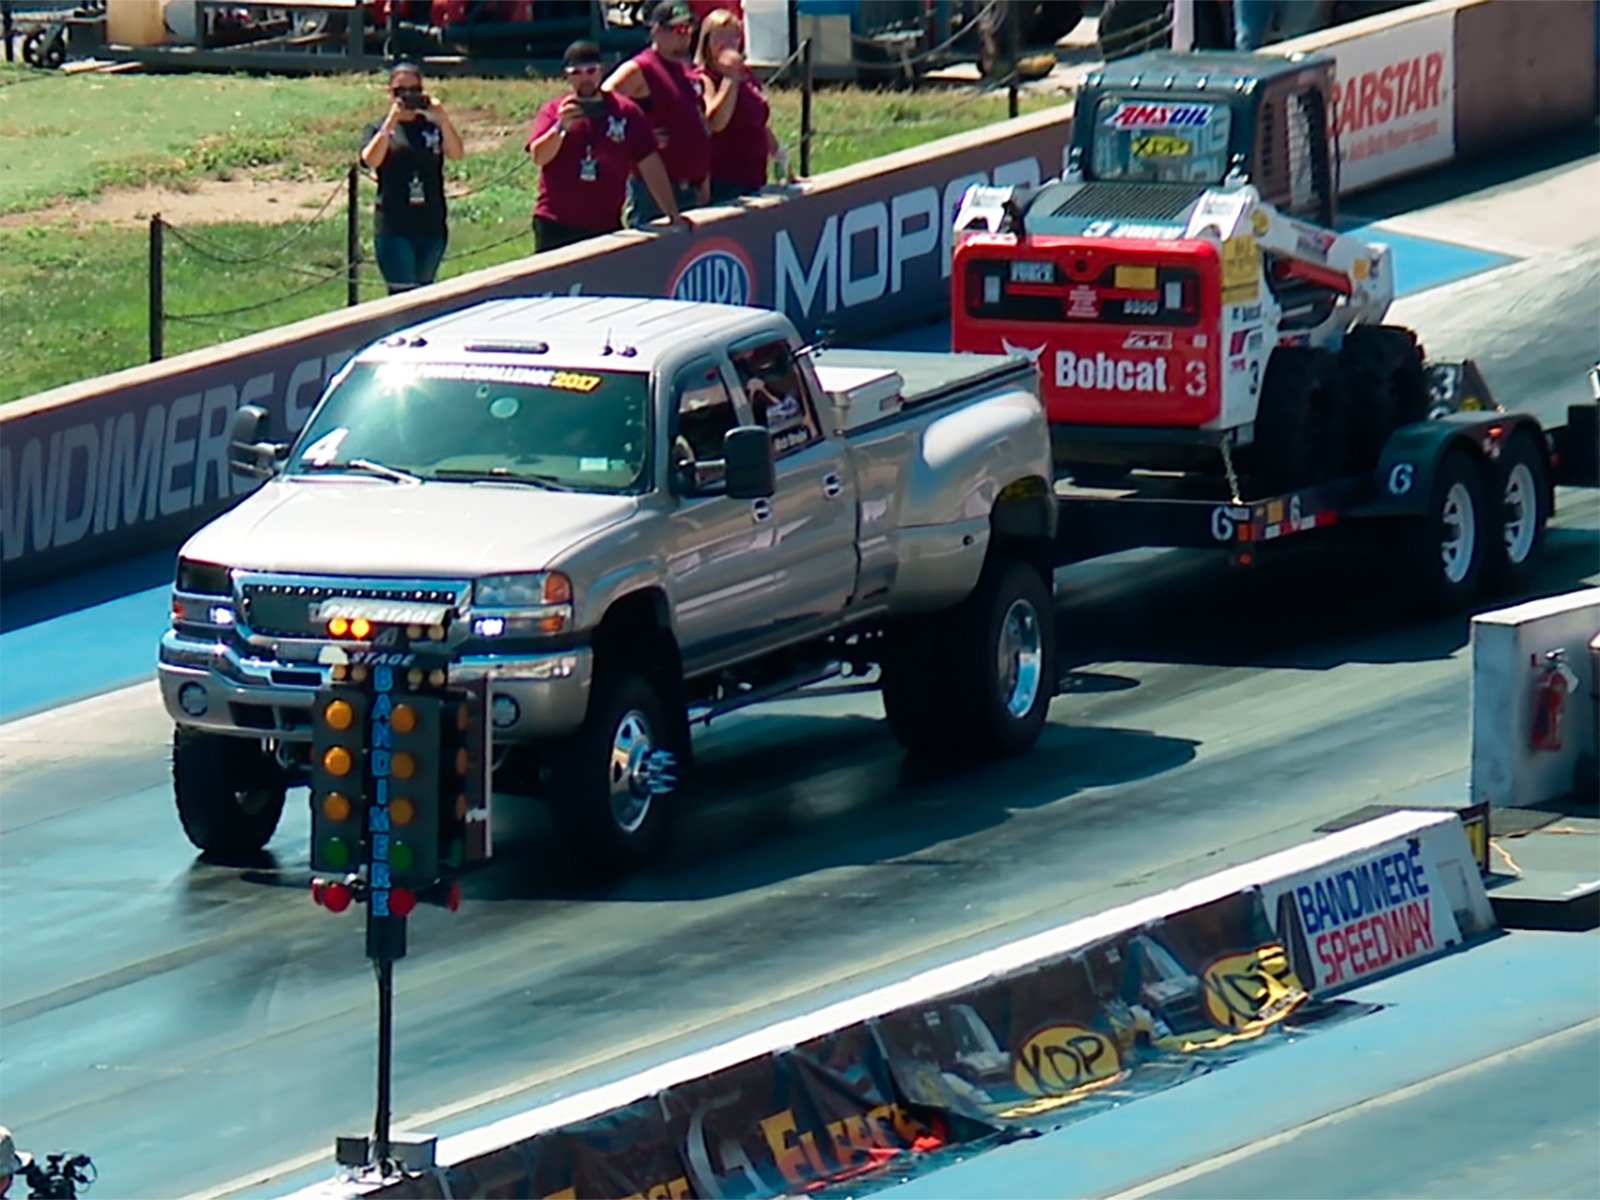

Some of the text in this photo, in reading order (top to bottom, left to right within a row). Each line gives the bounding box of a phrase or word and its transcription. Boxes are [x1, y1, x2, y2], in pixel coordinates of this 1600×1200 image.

[1113, 104, 1211, 126] AMSOIL
[774, 157, 1042, 318] MOP
[551, 371, 601, 392] 2017
[1055, 350, 1208, 396] Bobcat 3
[1248, 360, 1259, 395] 3
[0, 372, 275, 561] NDIMER
[302, 427, 349, 468] 4
[1388, 463, 1415, 494] 6
[1211, 505, 1234, 541] 6
[1289, 494, 1302, 530] 6
[350, 652, 416, 666] STAGE
[369, 665, 394, 916] BANDIMERE
[1296, 848, 1430, 935] BANDIMERE
[1315, 897, 1434, 986] SPEEDWAY
